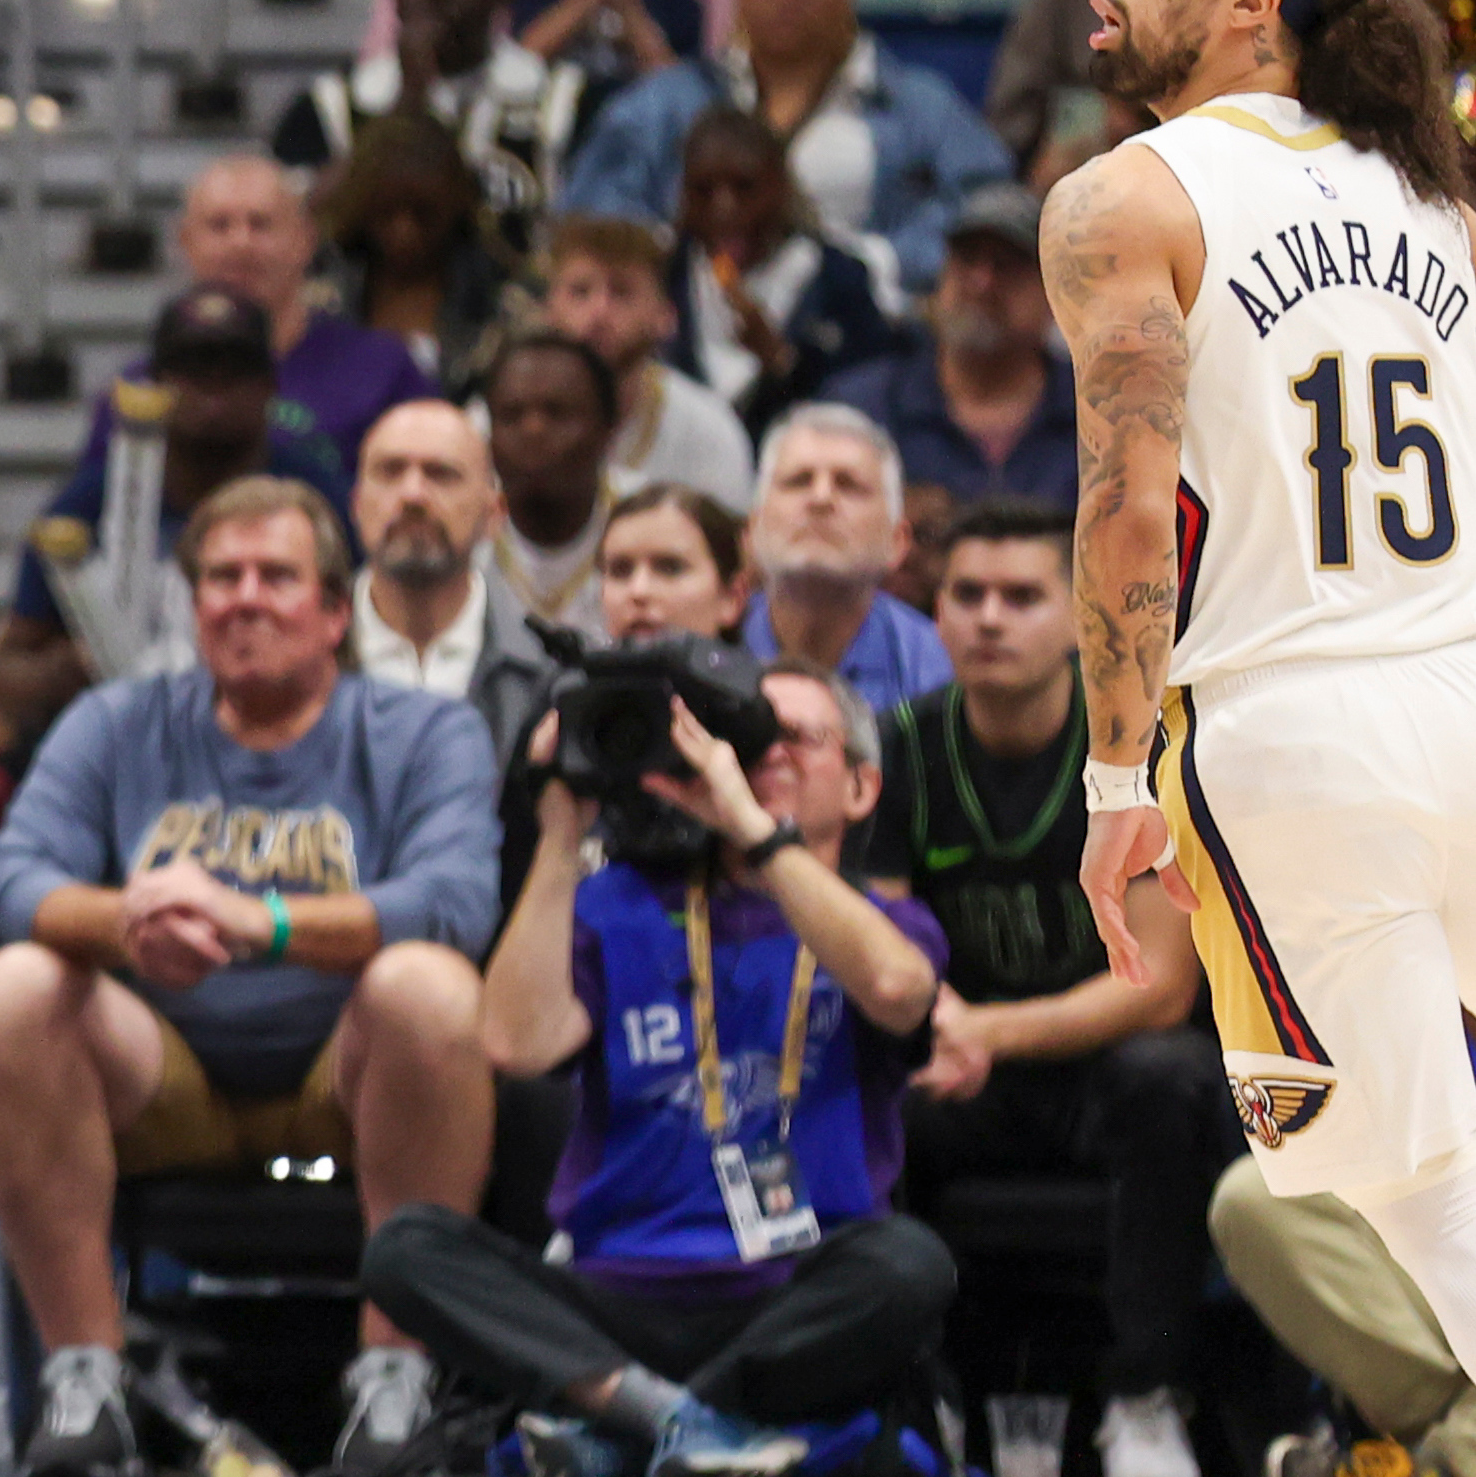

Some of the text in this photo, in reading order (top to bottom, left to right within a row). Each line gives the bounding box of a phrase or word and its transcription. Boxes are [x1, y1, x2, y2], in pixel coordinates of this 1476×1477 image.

[1227, 220, 1469, 342] ALVARADO
[1288, 351, 1460, 571] 15
[622, 1003, 685, 1067] 12
